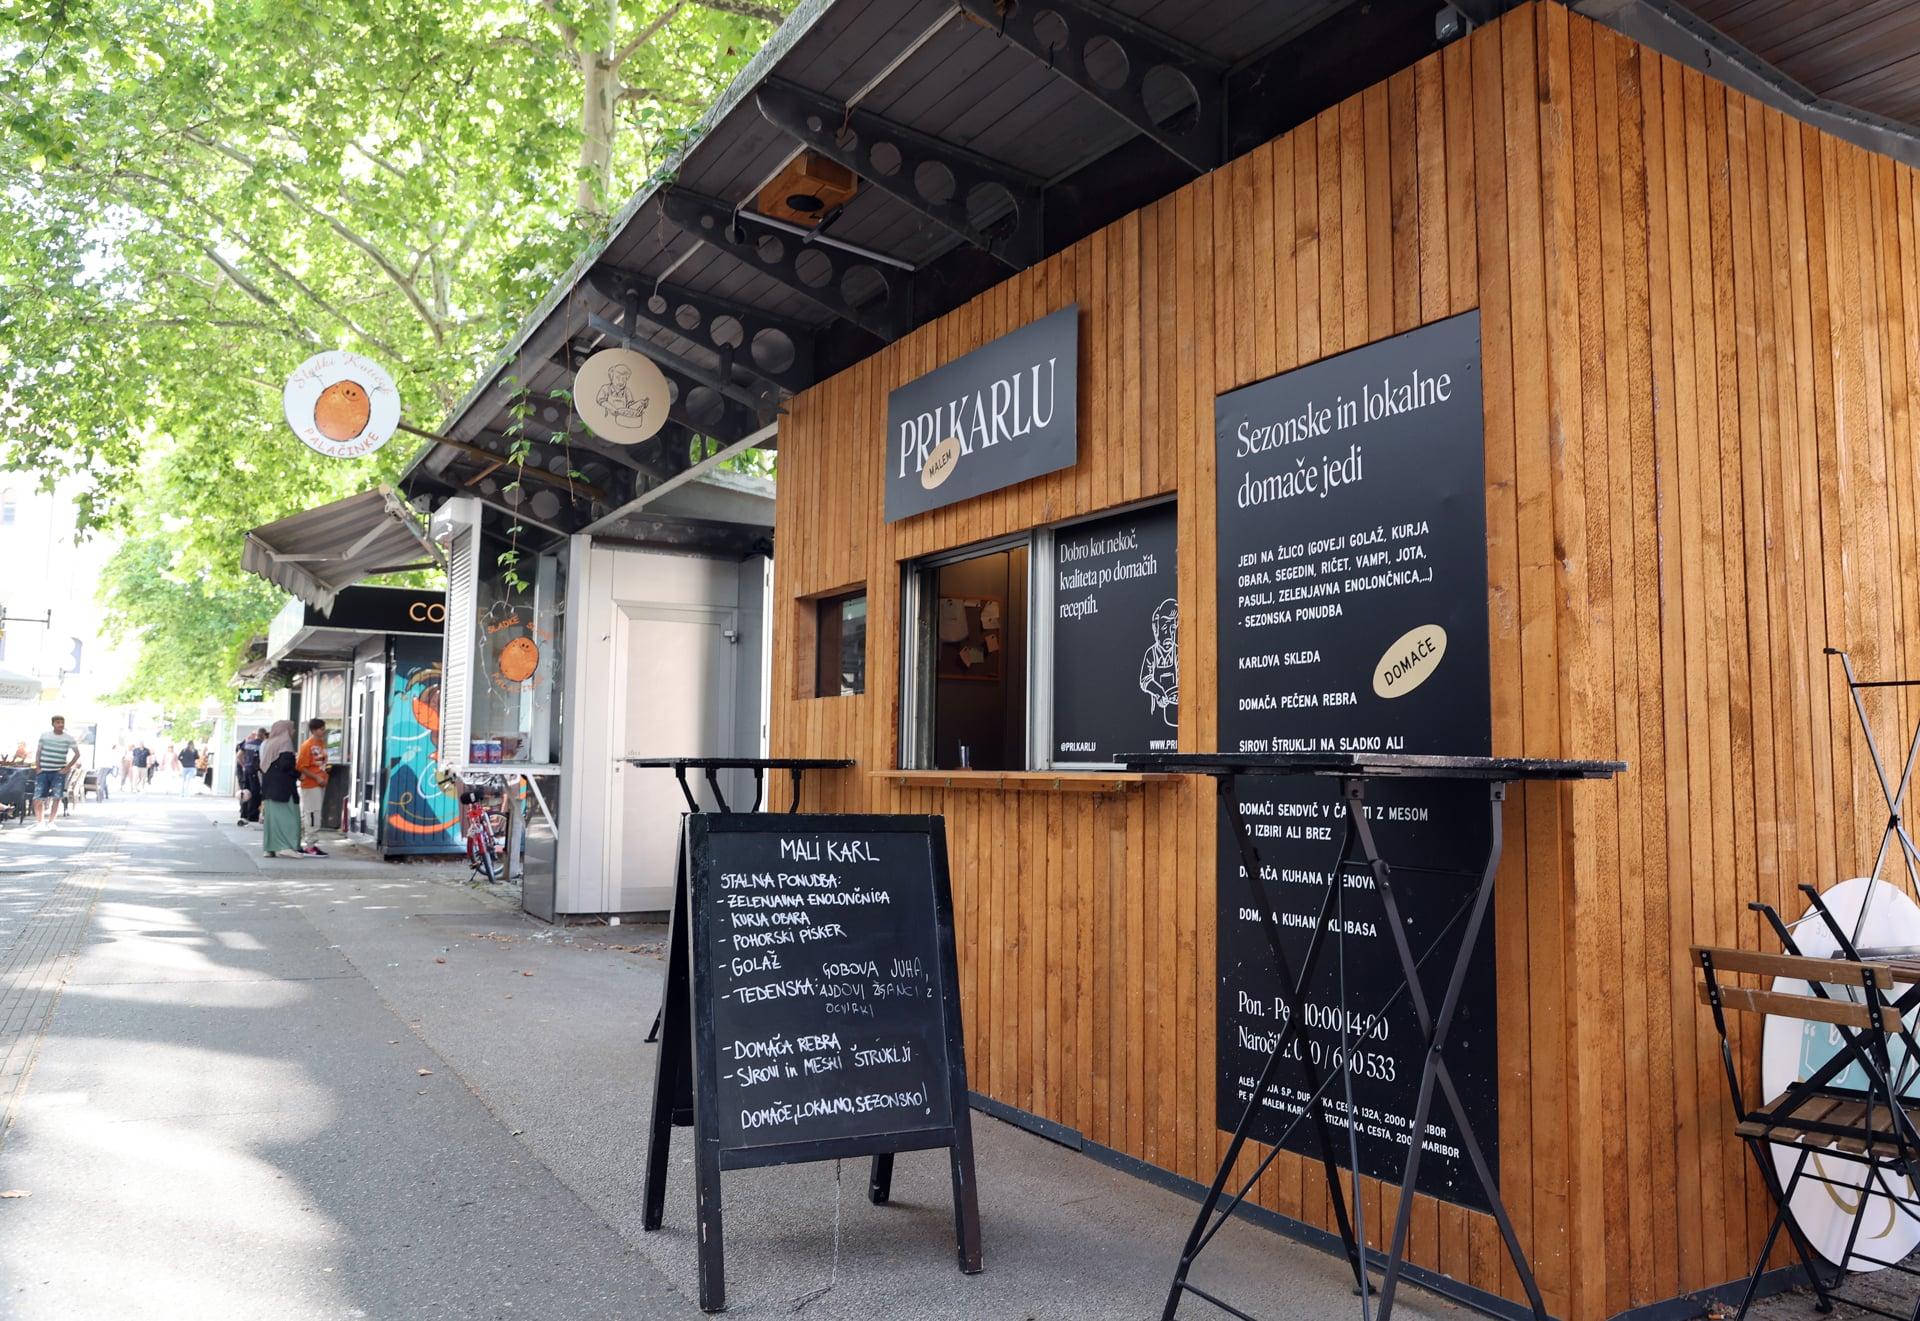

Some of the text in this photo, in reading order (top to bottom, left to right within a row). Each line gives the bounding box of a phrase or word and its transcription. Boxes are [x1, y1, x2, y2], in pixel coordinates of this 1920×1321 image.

[950, 357, 1056, 456] KARLU
[1237, 369, 1451, 457] Sezonske in lokalne
[1238, 444, 1362, 508] domače jedi
[1060, 528, 1137, 563] Dobro kot nekoč,
[1238, 521, 1428, 567] JEDI NA ŽLICO (GOVEJI GOLAŽ, KURJA
[1060, 554, 1156, 591] kvaliteta po domačih
[1238, 546, 1426, 587] OBARA, SEGEDIN, RIČET, VAMPI, JOTA,
[1060, 594, 1098, 619] receptih.
[1238, 593, 1275, 608] PASULJ,
[1279, 584, 1340, 602] ZELENJAVNA
[1245, 611, 1291, 628] SEZONSKA
[1296, 604, 1342, 622] PONUDBA
[1239, 650, 1320, 669] KARLOVA SKLEDA
[1384, 637, 1436, 686] DOMAČE
[1239, 692, 1357, 711] DOMAČA PEČENA REBRA
[1239, 736, 1404, 752] SIROVI ŠTRUKLJI NA SLADKO ALI
[1240, 801, 1273, 815] DOMAČI
[1278, 802, 1318, 817] SENDVIČ
[1323, 805, 1329, 818] V
[1377, 807, 1383, 820] Z
[1389, 807, 1428, 821] MESOM
[1255, 824, 1281, 837] IZBIRI
[1286, 826, 1301, 838] ALI
[1306, 827, 1331, 840] BREZ
[781, 836, 880, 863] MALI KARL
[720, 873, 775, 889] STALNA
[1282, 869, 1323, 885] KUHANA
[731, 912, 810, 928] KURJA OBARA
[733, 924, 847, 950] POHORSKI PISKER
[731, 950, 781, 976] GOLAŽ
[823, 961, 879, 979] GOBOVA
[1239, 990, 1265, 1016] Pon.
[734, 1033, 841, 1060] DOMAČA REBRA
[737, 1060, 779, 1087] SIROVI
[804, 1051, 842, 1075] MESNI
[850, 1041, 911, 1067] ŠTRUKLJI
[1366, 1053, 1396, 1081] 533
[1384, 1114, 1405, 1127] 2000
[1421, 1140, 1460, 1158] MARIBOR
